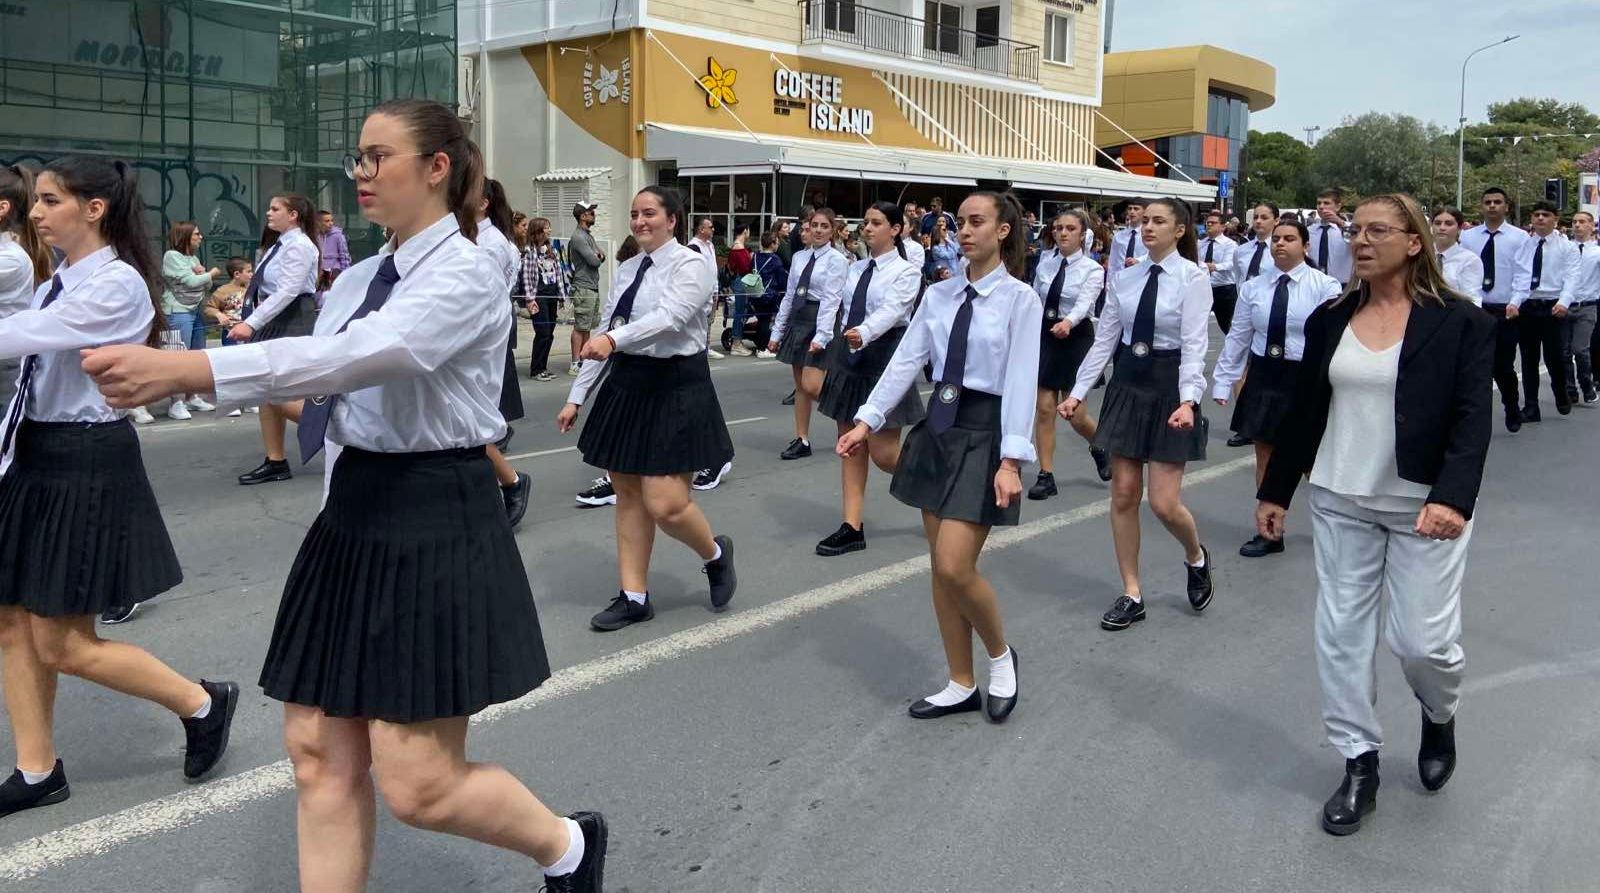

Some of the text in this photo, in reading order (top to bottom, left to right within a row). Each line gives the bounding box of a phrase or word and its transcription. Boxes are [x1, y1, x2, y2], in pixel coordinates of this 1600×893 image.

[583, 62, 594, 108] COFFEE
[621, 57, 630, 104] ISLAND
[774, 68, 843, 103] COFFEE
[809, 103, 874, 135] ISLAND
